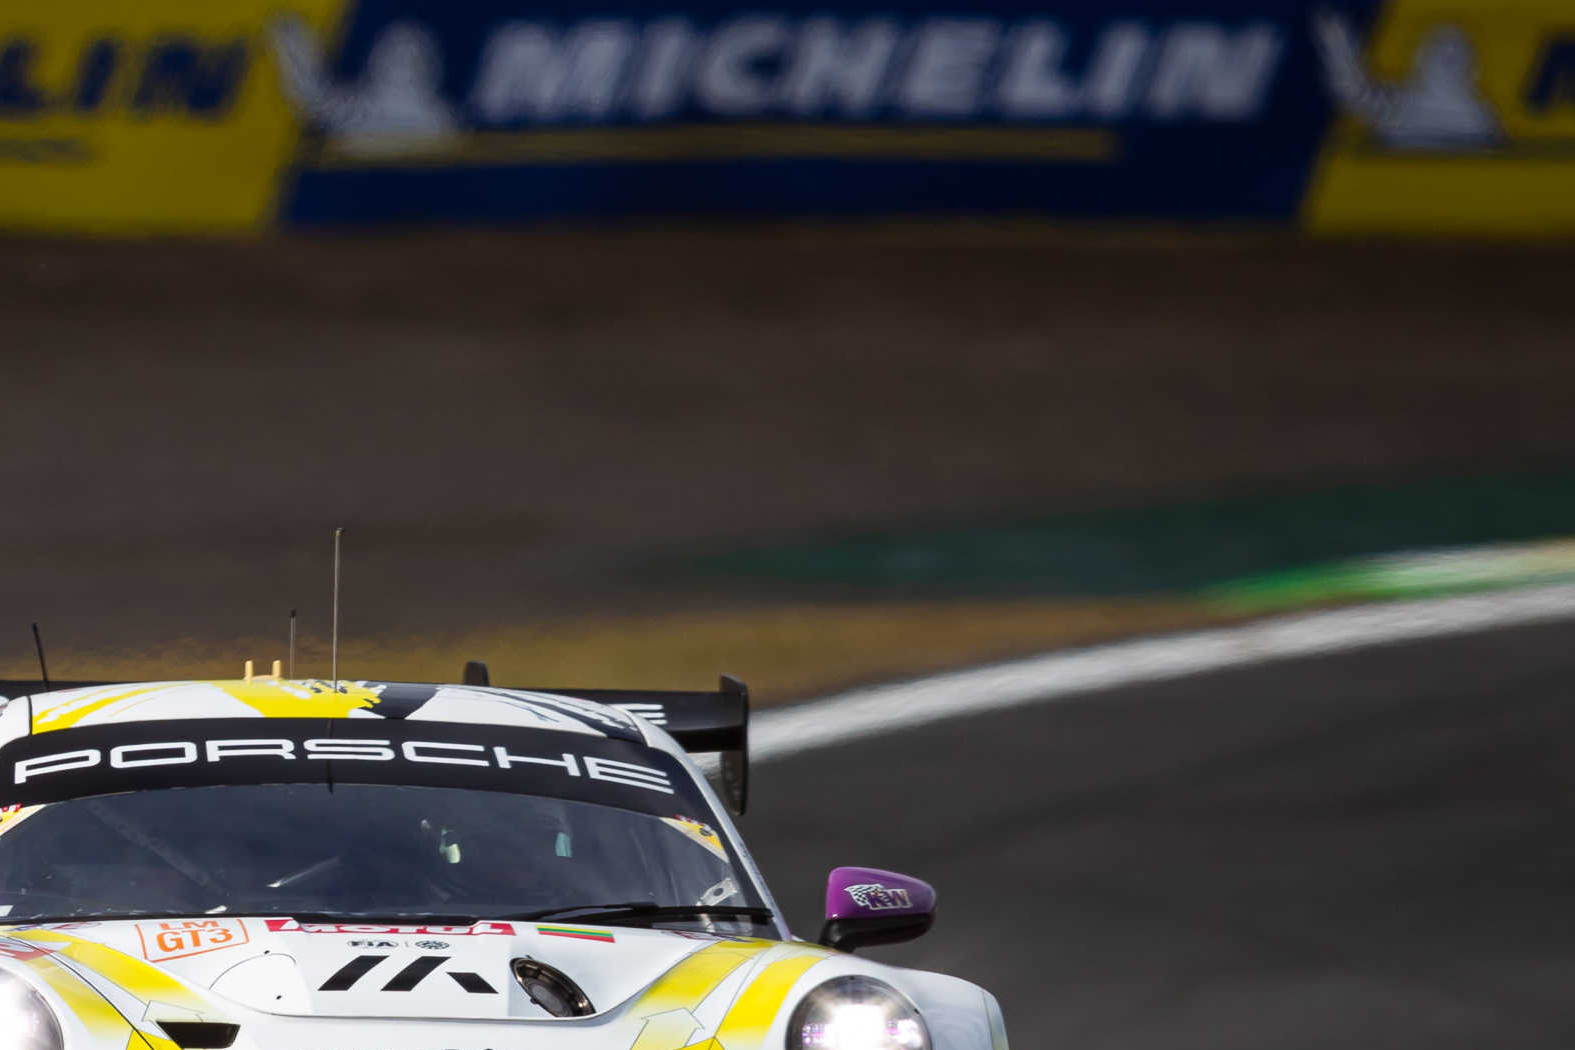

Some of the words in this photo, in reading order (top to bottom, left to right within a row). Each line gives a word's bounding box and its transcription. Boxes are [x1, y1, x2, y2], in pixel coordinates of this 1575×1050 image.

[473, 21, 1283, 121] MICHELIN
[13, 738, 675, 795] PORSCHE
[156, 928, 234, 952] GT3
